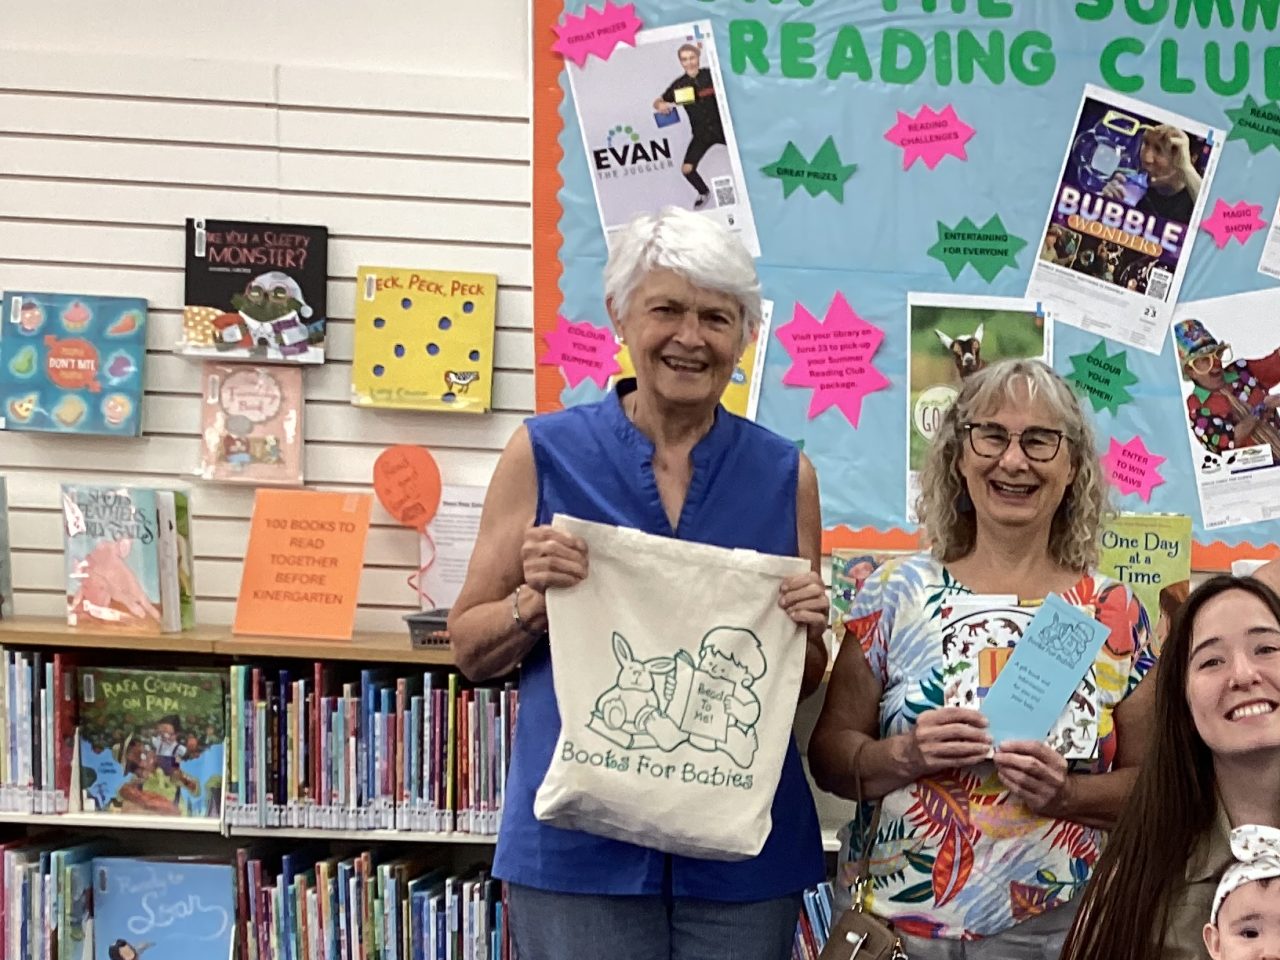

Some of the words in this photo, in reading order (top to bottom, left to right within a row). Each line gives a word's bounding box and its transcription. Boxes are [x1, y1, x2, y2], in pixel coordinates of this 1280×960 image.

[567, 31, 596, 44] GREAT
[597, 21, 627, 37] PRIZES
[729, 19, 1055, 86] READING
[908, 120, 948, 132] READING
[900, 132, 959, 146] CHALLENGES
[593, 138, 671, 170] EVAN
[597, 170, 620, 179] THE
[624, 160, 674, 175] JUGGLER
[777, 167, 804, 178] GREAT
[807, 171, 838, 182] PRIZES
[1057, 186, 1183, 252] BUBBLE
[1222, 209, 1251, 218] MAGIC
[1074, 215, 1158, 254] WONDERS
[1225, 223, 1252, 232] SHOW
[944, 232, 1008, 242] ENTERTAINING
[208, 246, 308, 270] MONSTER?
[944, 246, 961, 256] FOR
[963, 246, 1009, 257] EVERYONE
[375, 276, 404, 291] ECK,
[451, 280, 485, 297] PECK
[49, 358, 75, 369] DON'T
[845, 367, 865, 375] Club
[1087, 355, 1122, 376] COLOUR
[1088, 371, 1111, 386] YOUR
[1122, 449, 1149, 465] ENTER
[1117, 460, 1128, 470] TO
[1129, 465, 1146, 477] WIN
[1112, 471, 1142, 488] DRAWS
[265, 519, 287, 530] 100
[290, 519, 335, 532] BOOKS
[340, 521, 356, 533] TO
[289, 537, 325, 549] READ
[1102, 530, 1139, 549] One
[1144, 532, 1179, 558] Day
[271, 554, 338, 567] TOGETHER
[1129, 552, 1140, 564] at
[1145, 556, 1151, 564] a
[275, 572, 327, 585] BEFORE
[1114, 565, 1161, 585] Time
[253, 590, 343, 604] KINERGARTEN
[101, 679, 139, 698] RAFA
[697, 682, 724, 701] Read
[145, 695, 179, 711] PAPA
[701, 699, 712, 712] To
[561, 740, 630, 771] Books
[637, 754, 676, 778] For
[681, 763, 754, 790] Babies
